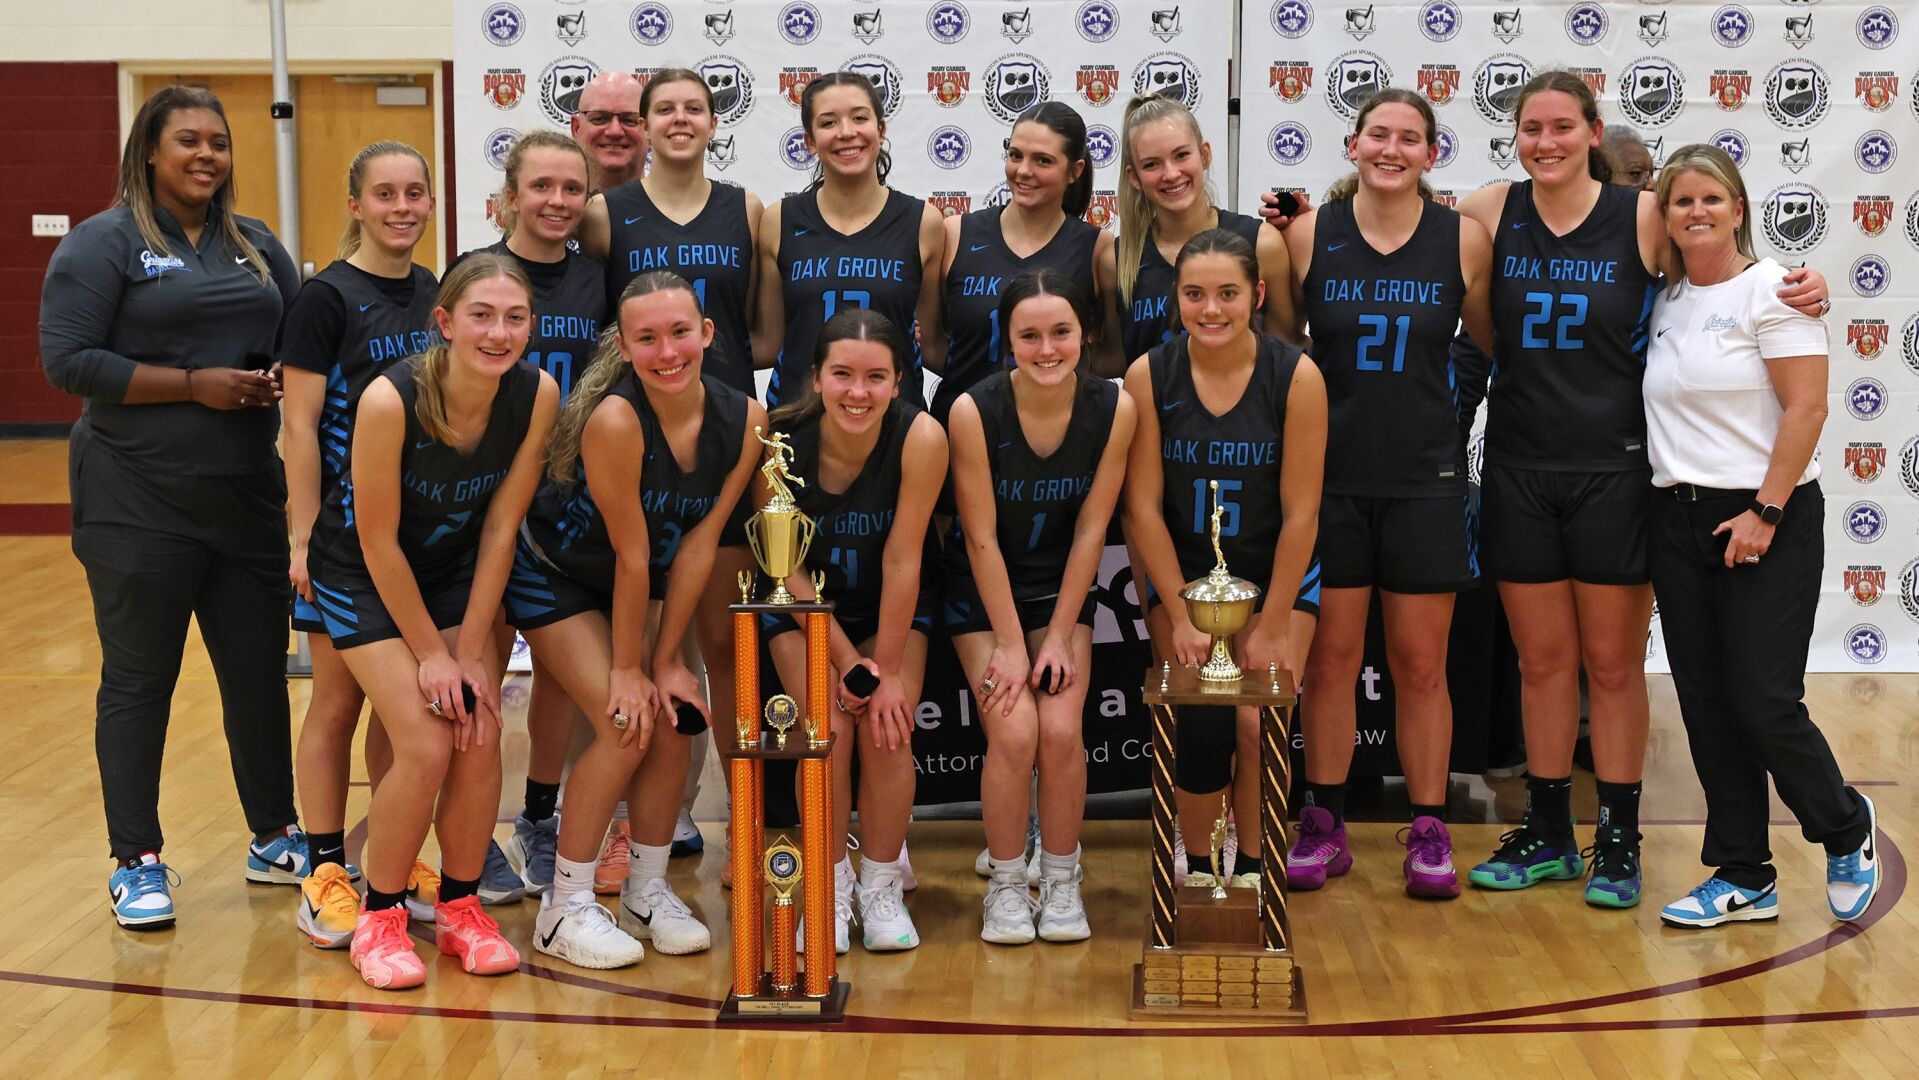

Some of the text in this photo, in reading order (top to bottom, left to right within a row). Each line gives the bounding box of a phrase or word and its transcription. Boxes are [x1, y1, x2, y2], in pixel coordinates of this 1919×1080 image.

[484, 74, 526, 96] HOLIDAY
[927, 71, 970, 93] HOLIDAY
[1075, 70, 1120, 92] HOLIDAY
[1269, 67, 1313, 89] HOLIDAY
[1416, 70, 1460, 91] HOLIDAY
[1709, 75, 1752, 97] HOLIDAY
[1855, 77, 1899, 98] HOLIDAY
[1852, 201, 1894, 222] HOLIDAY
[629, 244, 740, 272] OAK GROVE
[791, 256, 904, 282] OAK GROVE
[1503, 256, 1618, 283] OAK GROVE
[962, 276, 1002, 296] OAK
[1324, 279, 1443, 305] OAK GROVE
[1134, 296, 1167, 322] OAK
[1522, 292, 1589, 350] 22
[541, 315, 597, 342] GROVE
[1847, 325, 1889, 346] HOLIDAY
[368, 333, 411, 362] OAK
[1356, 314, 1411, 372] 21
[1208, 441, 1277, 466] GROVE
[1844, 448, 1887, 469] HOLIDAY
[404, 469, 448, 503] OAK
[994, 473, 1025, 501] AK
[642, 490, 669, 512] AK
[1193, 478, 1243, 537] 15
[1028, 512, 1047, 551] 1
[1843, 571, 1886, 592] HOLIDAY
[912, 753, 985, 775] Attor
[1084, 741, 1109, 763] nd
[1355, 729, 1387, 746] aw
